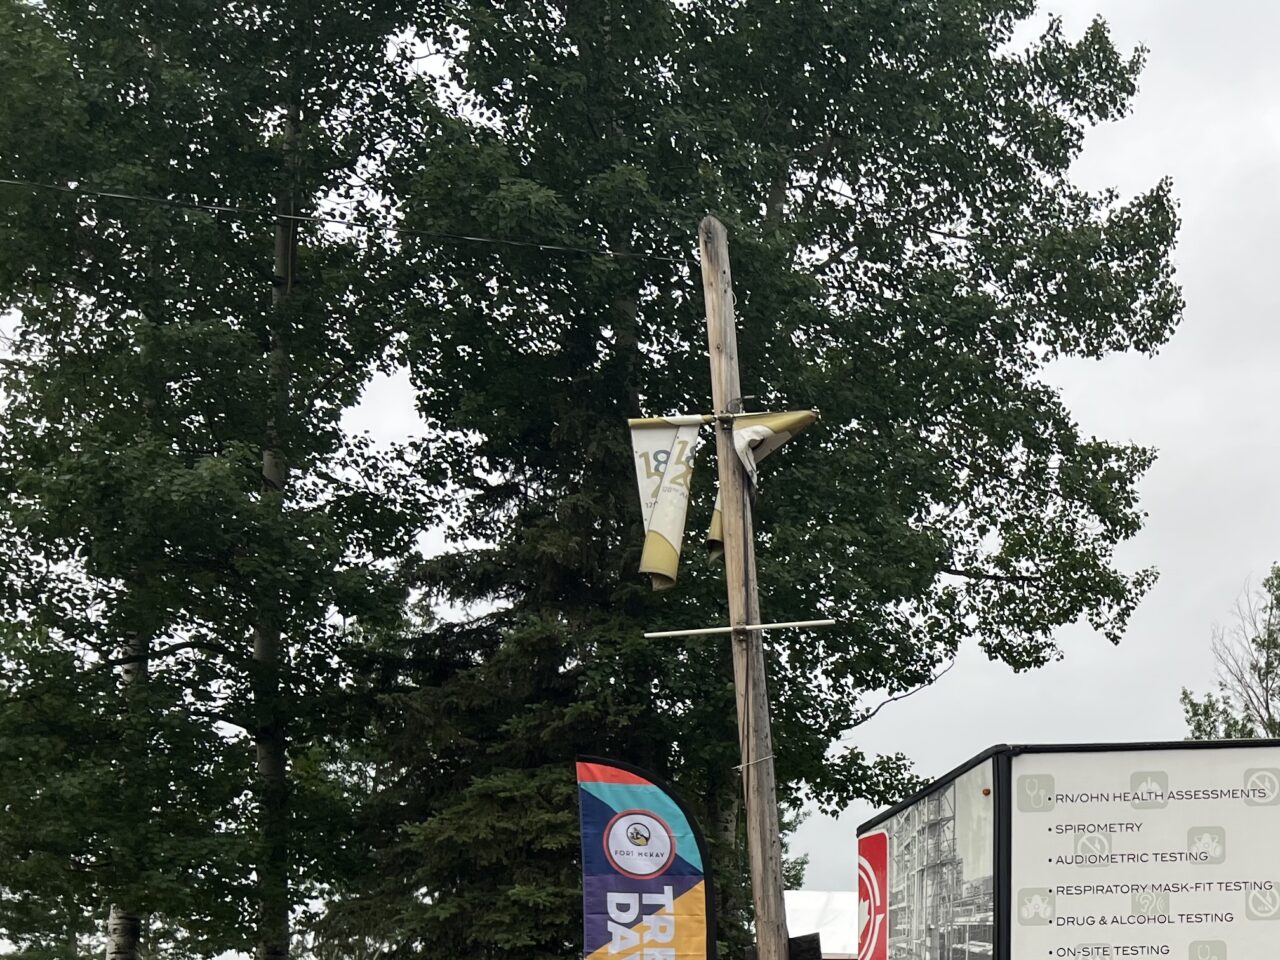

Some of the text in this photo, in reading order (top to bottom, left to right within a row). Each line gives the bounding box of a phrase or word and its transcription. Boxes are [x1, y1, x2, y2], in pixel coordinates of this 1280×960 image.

[1055, 788, 1267, 804] RN/OHN HEALTH ASSESSMENTS
[1055, 822, 1143, 834] SPIROMETRY
[1055, 851, 1208, 865] AUDIOMETRIC TESTING
[1056, 880, 1273, 896] RESPIRATORY MASK-FIT TESTING
[1056, 912, 1234, 927] DRUG & ALCOHOL TESTING
[1056, 944, 1170, 957] ON-SITE TESTING
